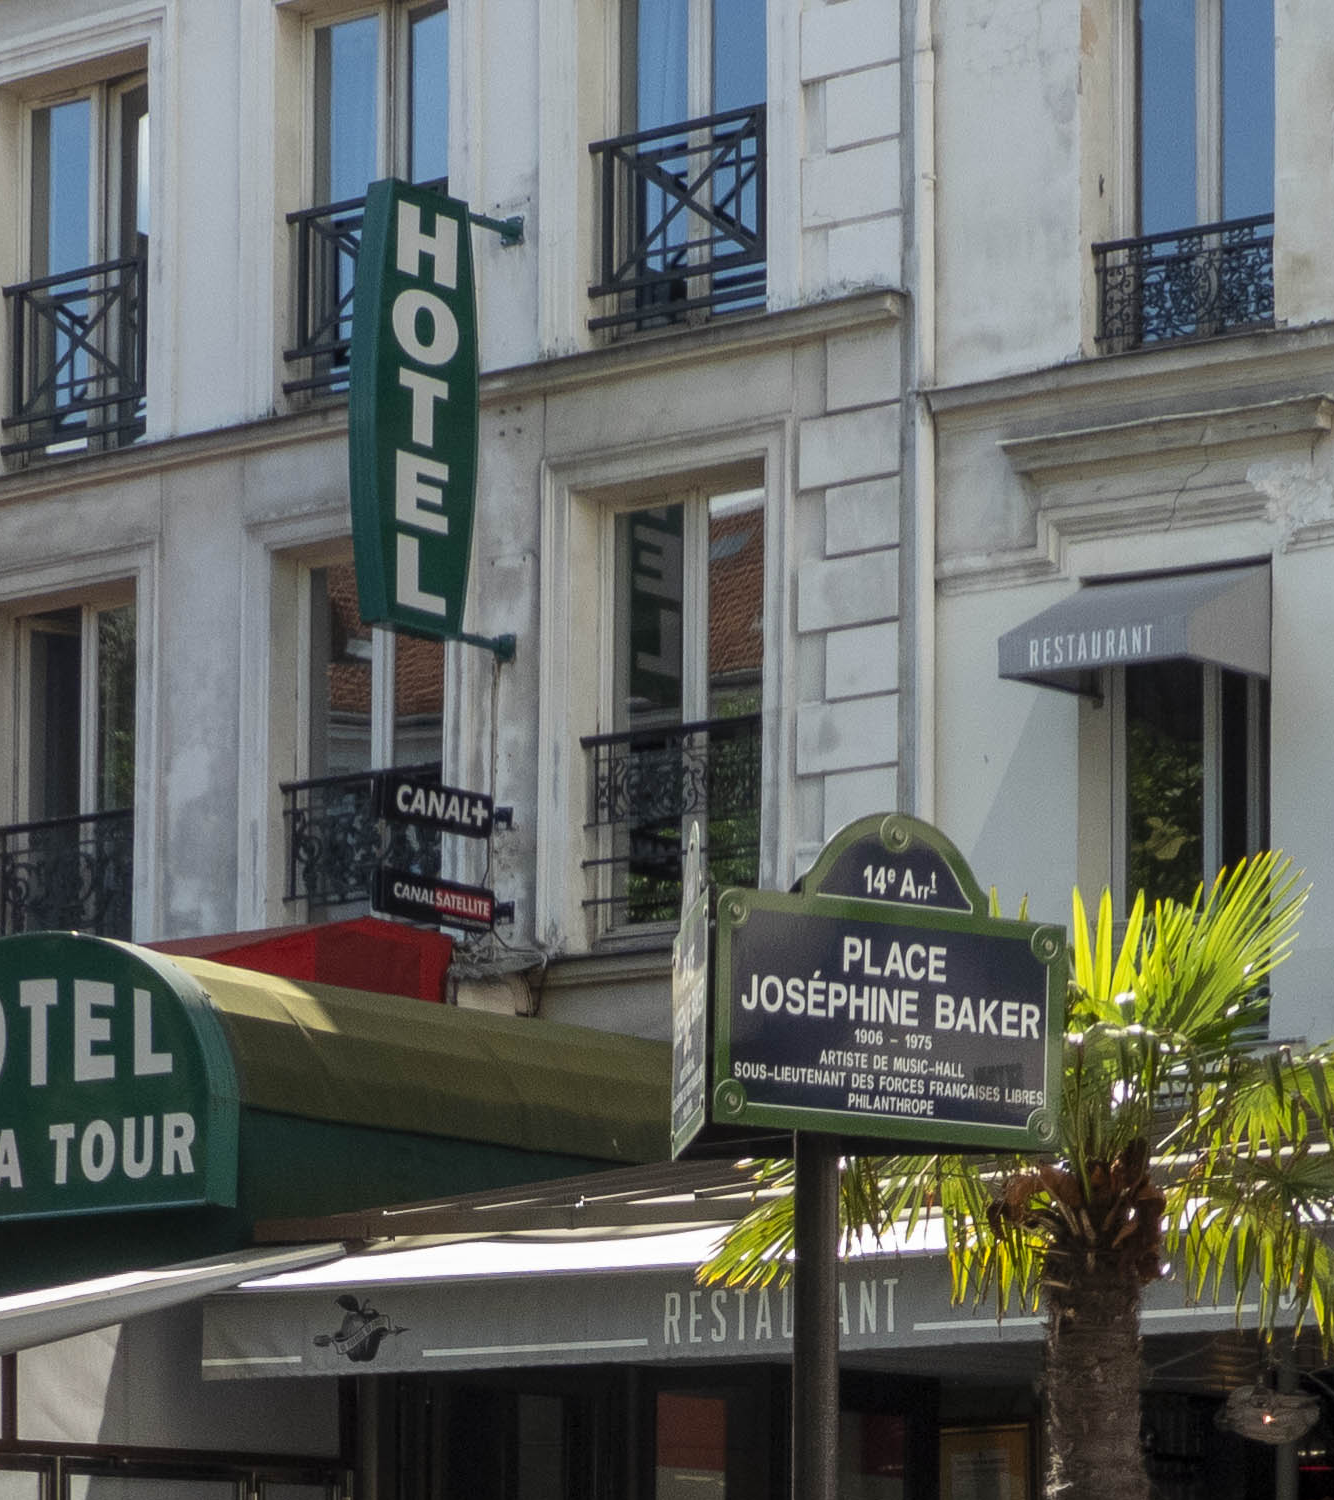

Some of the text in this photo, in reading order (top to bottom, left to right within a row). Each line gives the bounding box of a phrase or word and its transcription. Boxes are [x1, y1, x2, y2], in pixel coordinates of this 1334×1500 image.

[391, 200, 459, 616] HOTEL
[1030, 624, 1153, 668] RESTAURANT
[396, 783, 489, 827] CANAL+
[842, 936, 948, 982] PLACE
[741, 971, 1041, 1040] JOSÉPHINE BAKER
[854, 1029, 884, 1046] 1906
[904, 1034, 933, 1051] 1975
[733, 1061, 1044, 1107] SOUS-LIEUTENANT DES FORCES FRANÇAISES LIBRES
[819, 1049, 965, 1079] ARTISTE DE MUSIC-HALL
[847, 1095, 935, 1117] PHILANTHROPE
[49, 1112, 196, 1185] TOUR
[664, 1277, 900, 1345] RESTAUANT
